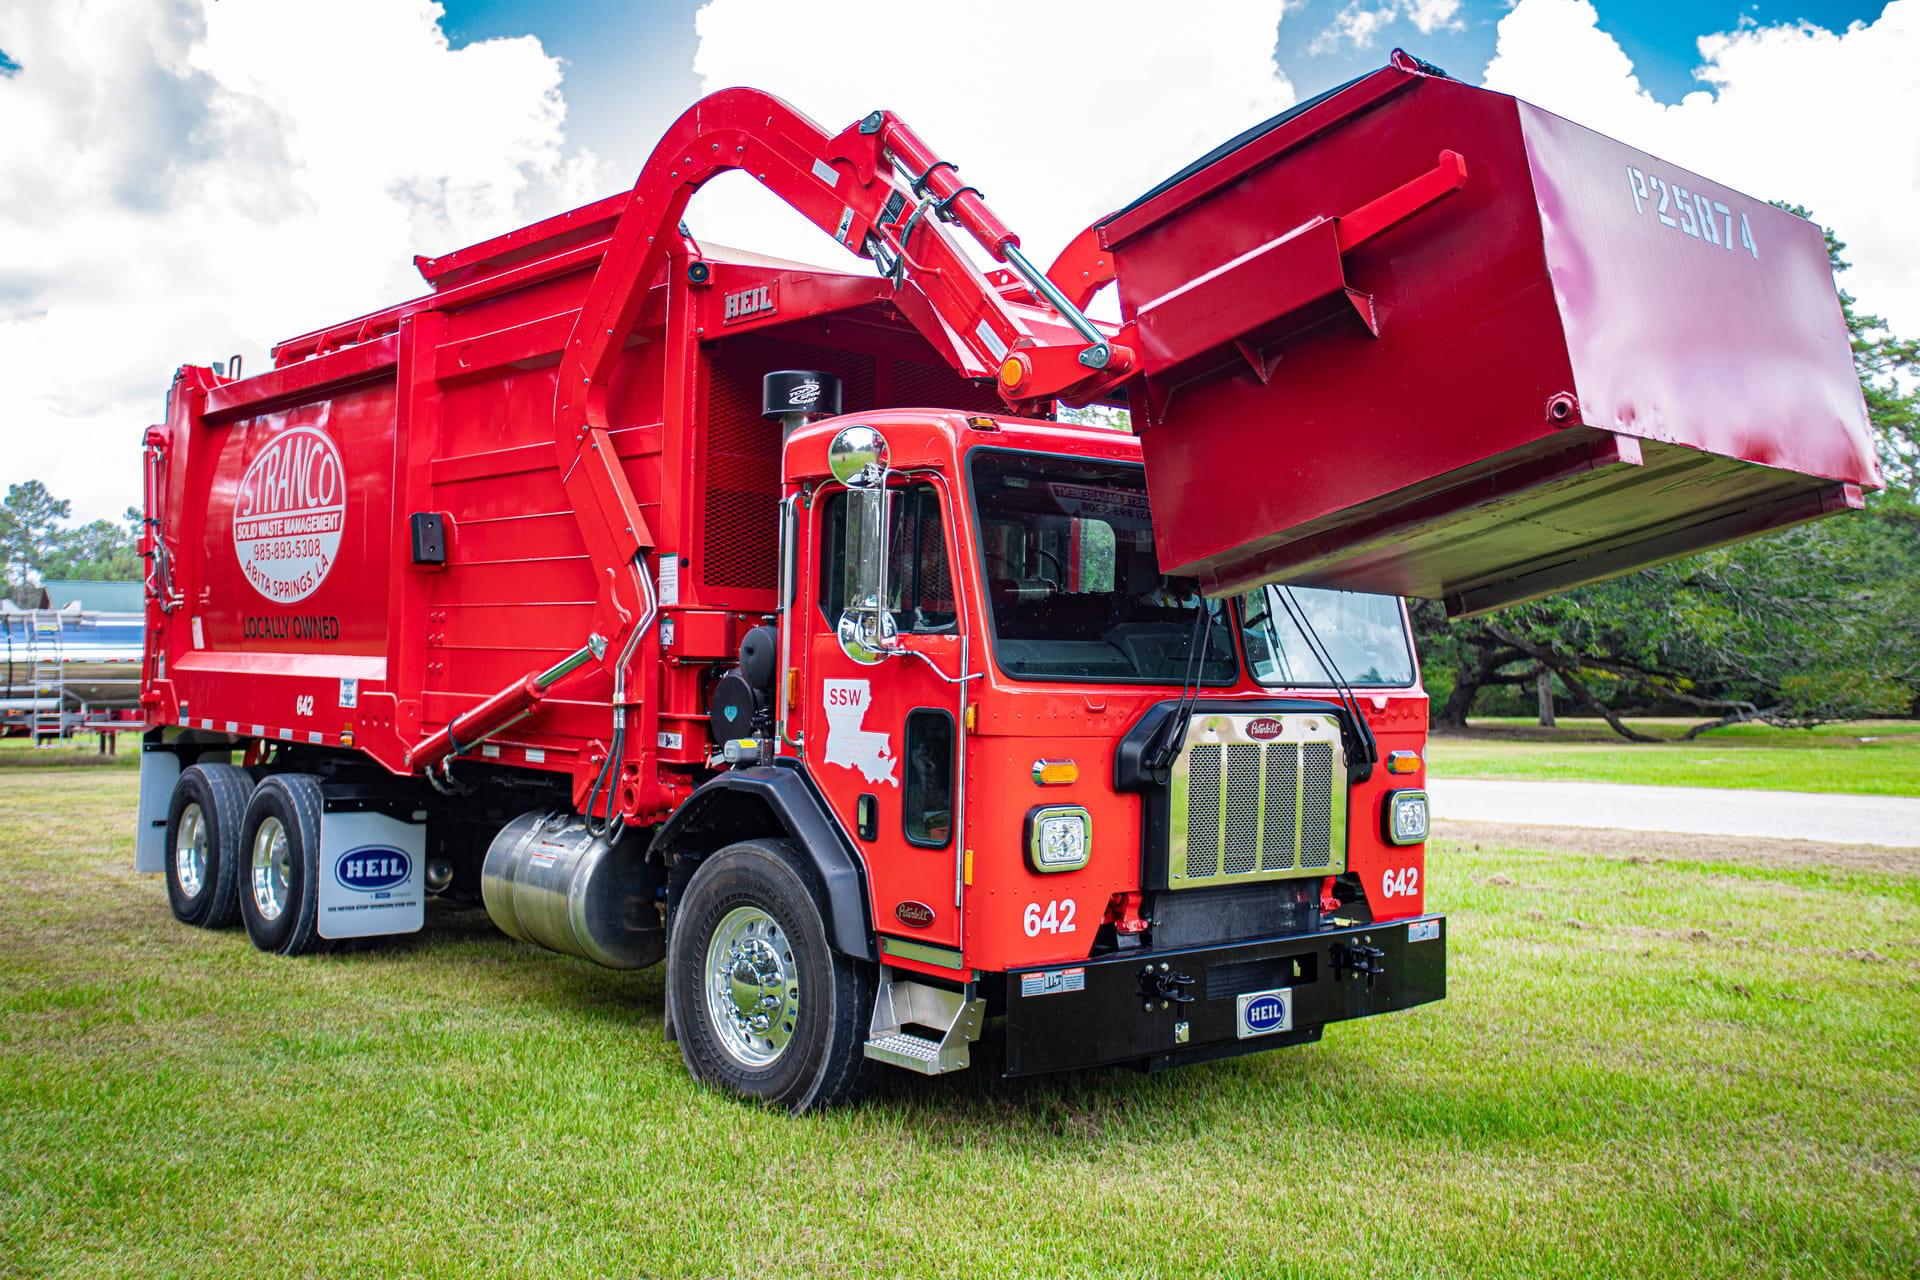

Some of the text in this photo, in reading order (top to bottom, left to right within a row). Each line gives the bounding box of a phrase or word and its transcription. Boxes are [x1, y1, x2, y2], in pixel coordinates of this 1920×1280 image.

[1626, 165, 1759, 259] P25874
[724, 286, 772, 319] HEIL
[243, 436, 336, 516] STRANCO
[237, 513, 340, 539] SOLID WASTE MANAGEMENT
[254, 538, 321, 561] 985-893-5308
[246, 553, 329, 598] ABITA SPRINGS, LA
[243, 616, 340, 640] LOCALLY OWNED
[296, 694, 314, 716] 642
[830, 688, 861, 706] SSW
[1251, 721, 1280, 735] Peterbilt
[346, 858, 403, 878] HEIL
[1383, 867, 1418, 898] 642
[899, 903, 930, 920] Peterbilt
[1023, 898, 1076, 937] 642
[1250, 1004, 1281, 1022] HEIL
